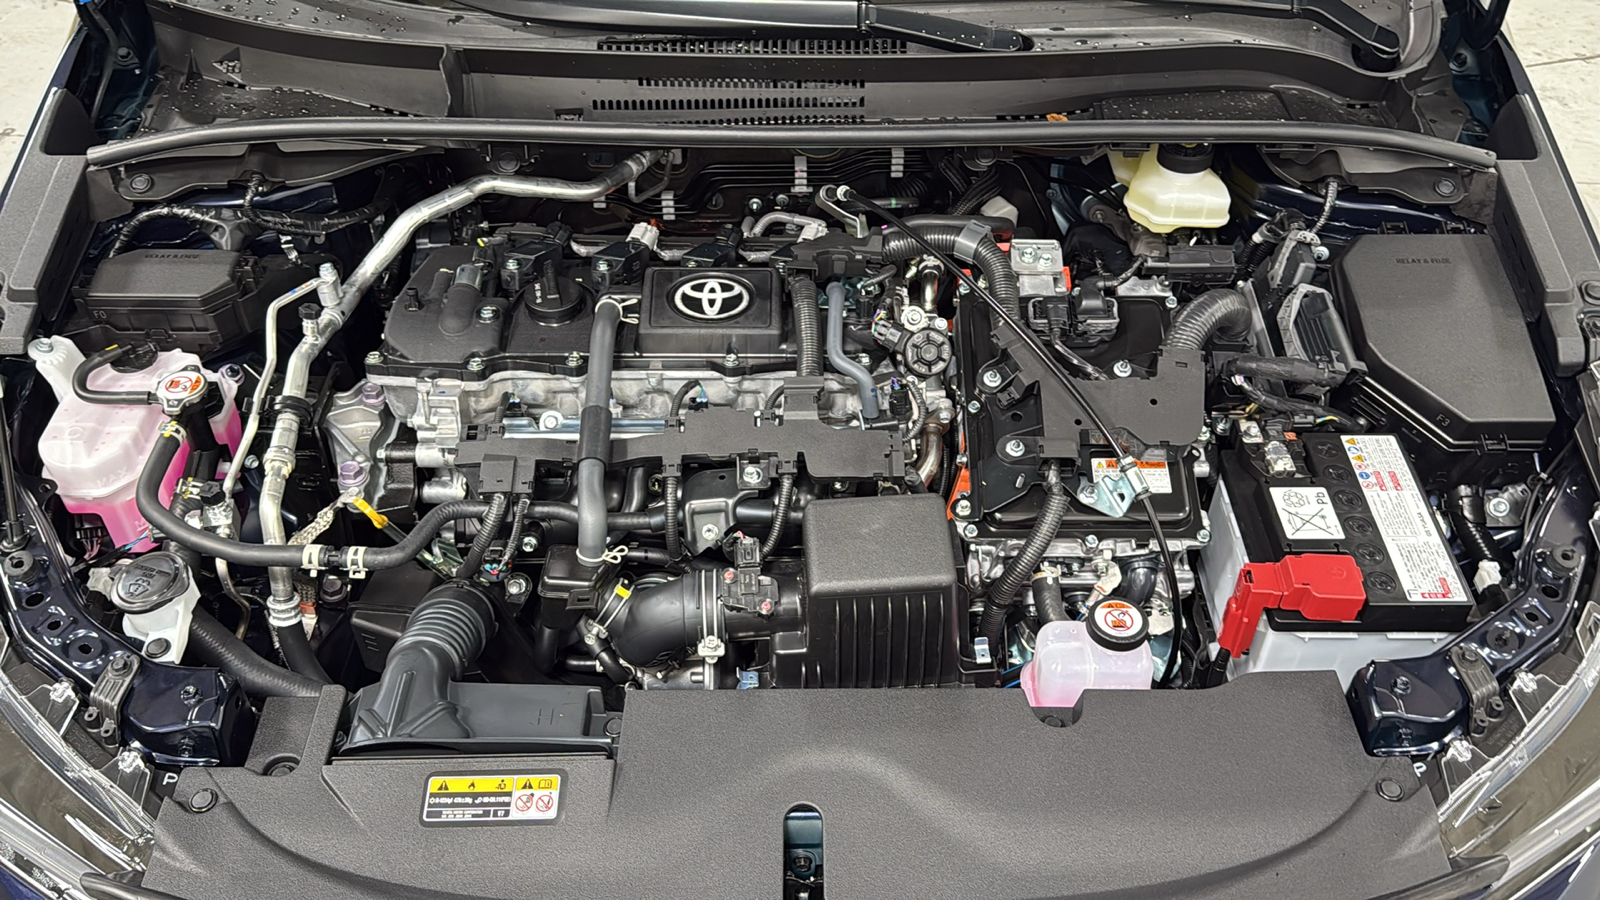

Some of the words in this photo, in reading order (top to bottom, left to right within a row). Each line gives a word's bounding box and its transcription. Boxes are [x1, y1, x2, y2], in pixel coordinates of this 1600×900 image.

[1436, 413, 1450, 427] F3
[97, 466, 127, 488] MAX
[1314, 491, 1328, 505] Pb
[1413, 762, 1427, 777] P
[162, 773, 178, 785] P
